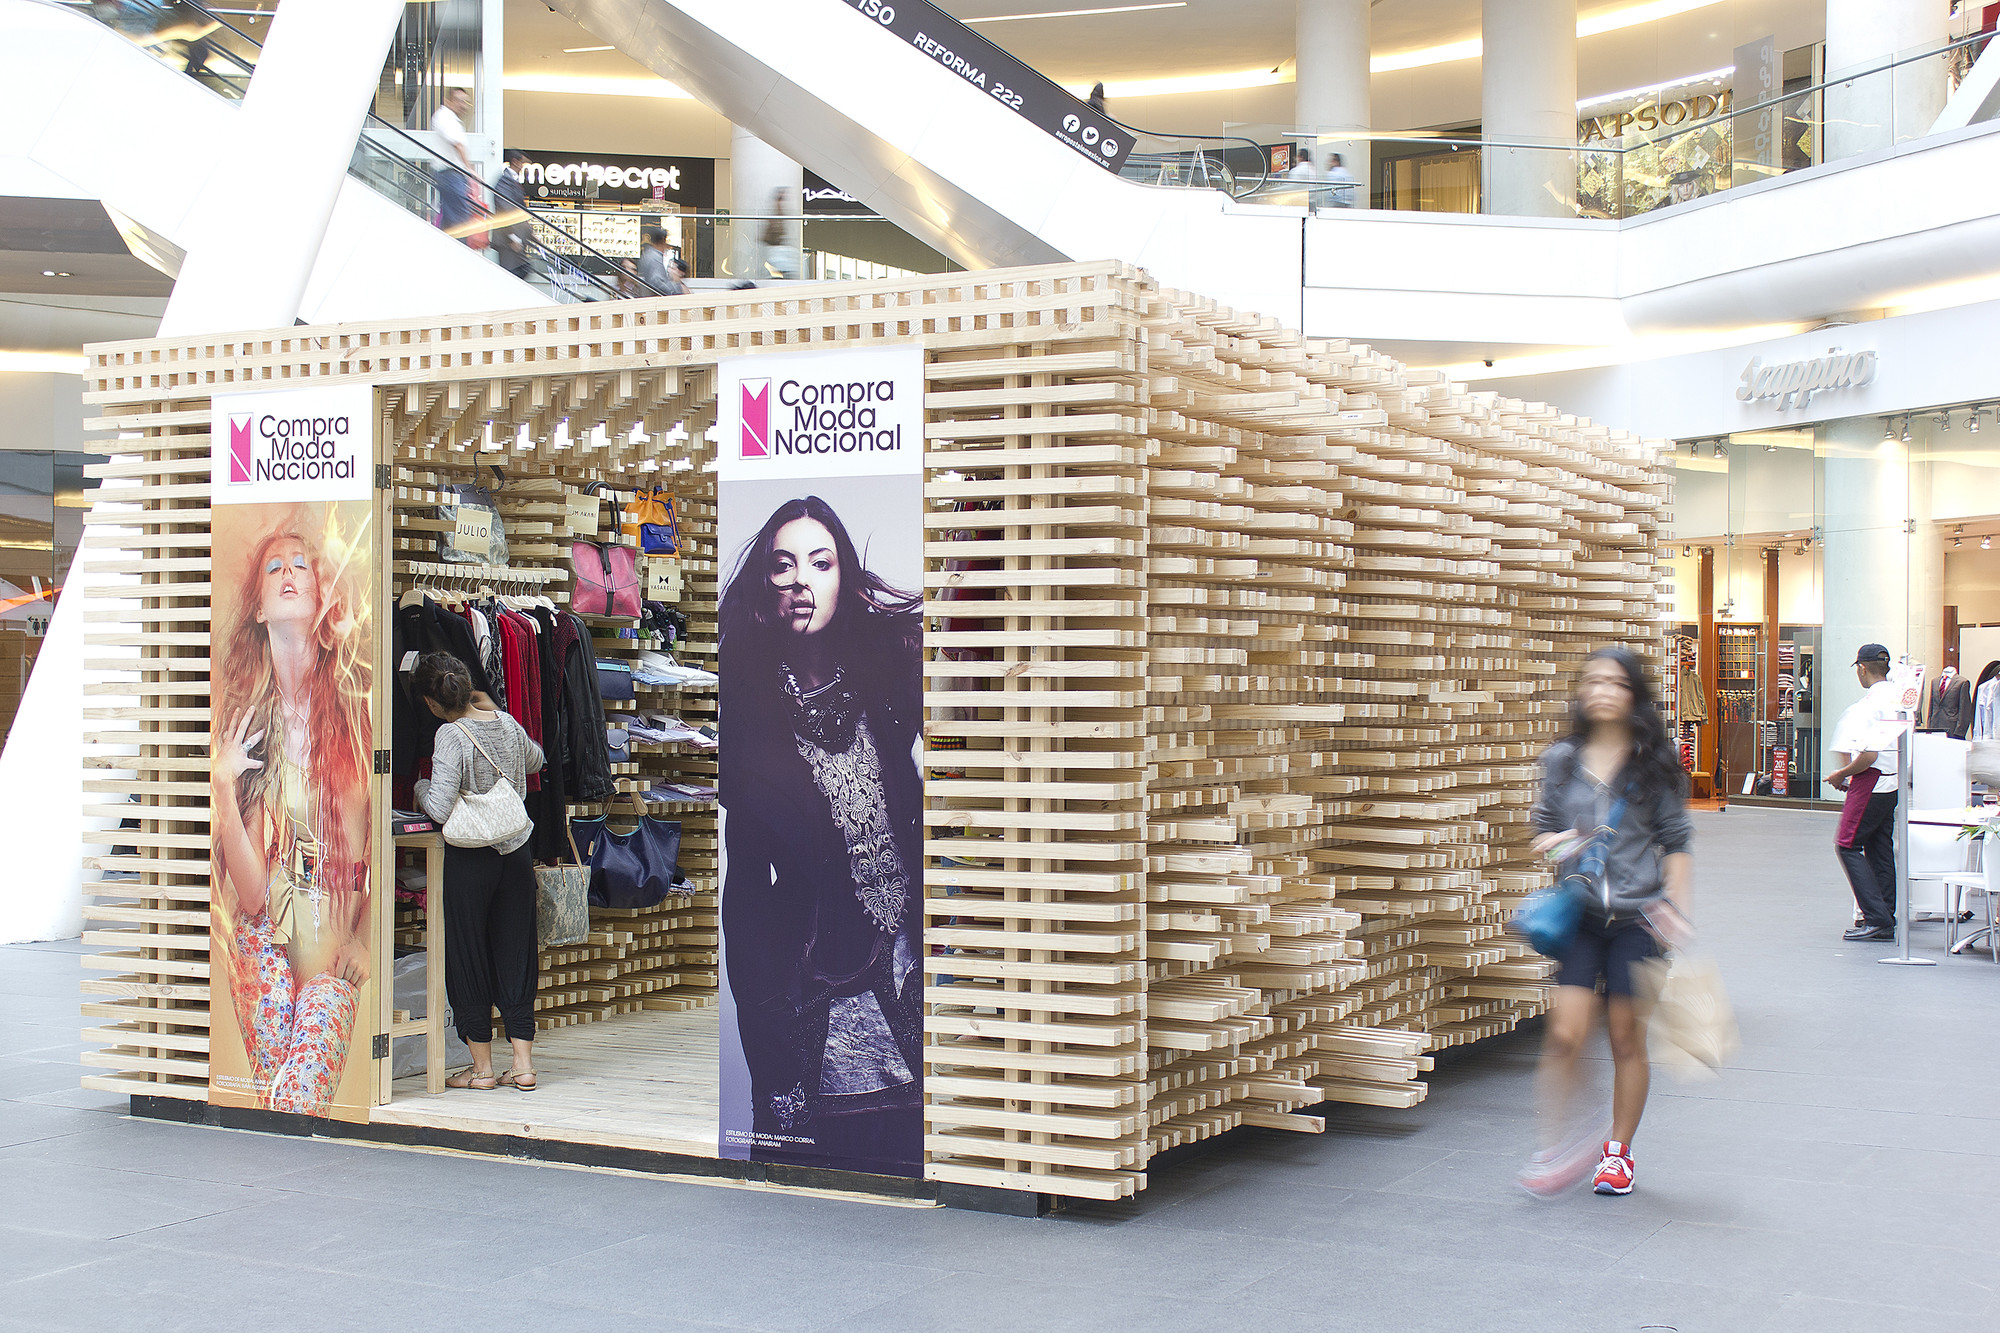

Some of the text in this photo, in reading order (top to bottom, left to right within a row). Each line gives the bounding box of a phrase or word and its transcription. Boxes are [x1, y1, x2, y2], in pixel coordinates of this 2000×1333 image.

[845, 0, 896, 26] ISO
[912, 31, 1024, 111] REFORMA 222
[1582, 88, 1734, 143] APSODI
[549, 188, 581, 197] sunglass
[1736, 347, 1876, 411] Scappino
[779, 380, 894, 409] Compra
[259, 414, 349, 441] Compra
[794, 403, 876, 432] Moda
[271, 436, 335, 460] Moda
[775, 424, 901, 455] Nacional
[256, 455, 354, 481] Nacional
[725, 1129, 748, 1137] ESTILISMO
[774, 1134, 794, 1142] MARCO
[794, 1136, 815, 1144] CORRAL
